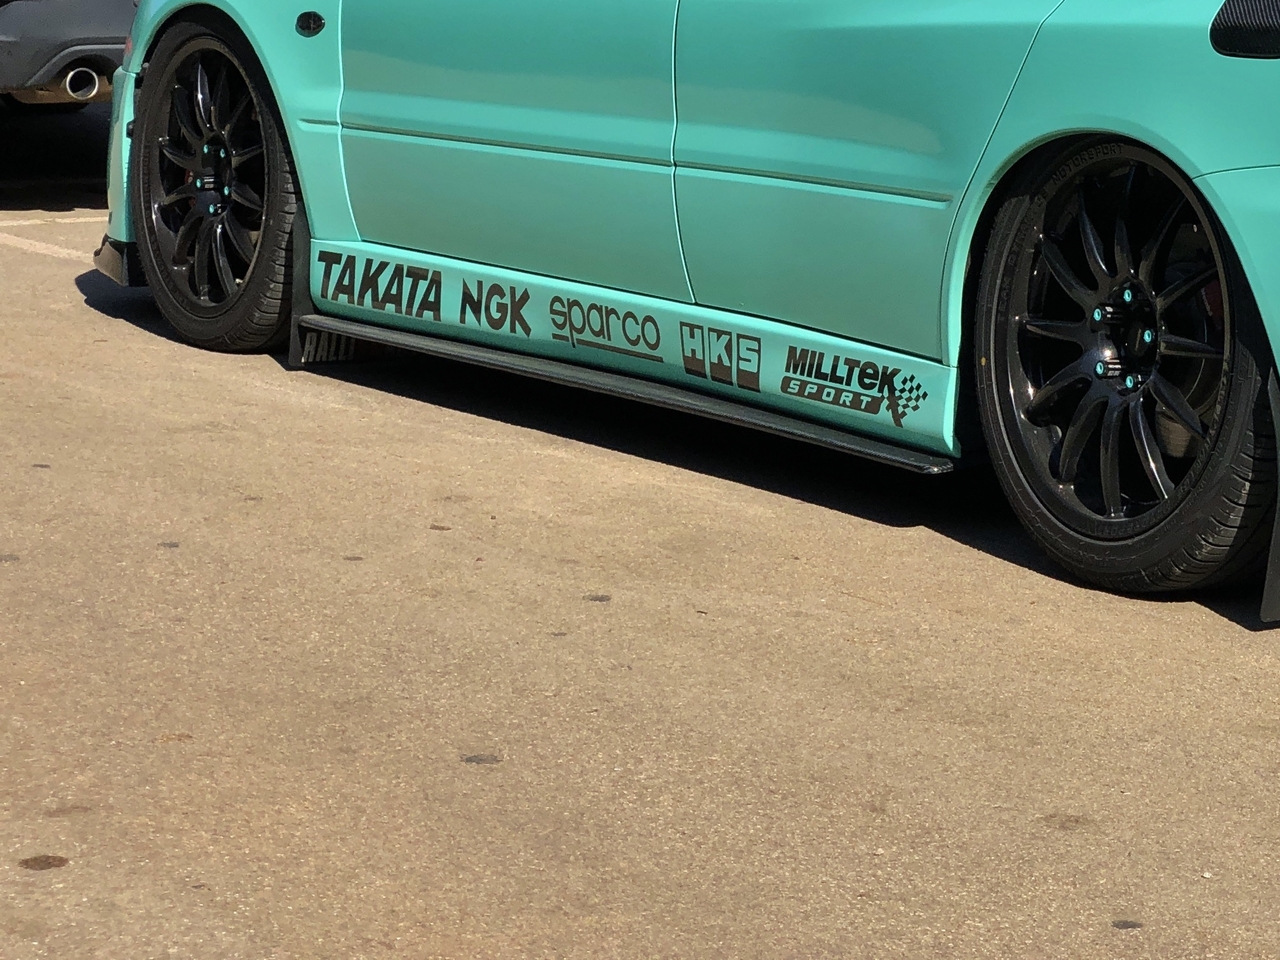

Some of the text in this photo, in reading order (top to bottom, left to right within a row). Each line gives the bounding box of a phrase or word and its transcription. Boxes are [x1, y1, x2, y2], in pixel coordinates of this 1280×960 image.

[317, 251, 442, 321] TAKATA
[459, 278, 533, 338] NGK
[549, 295, 661, 350] sparco
[680, 320, 762, 393] HKS
[787, 381, 872, 411] SPORT
